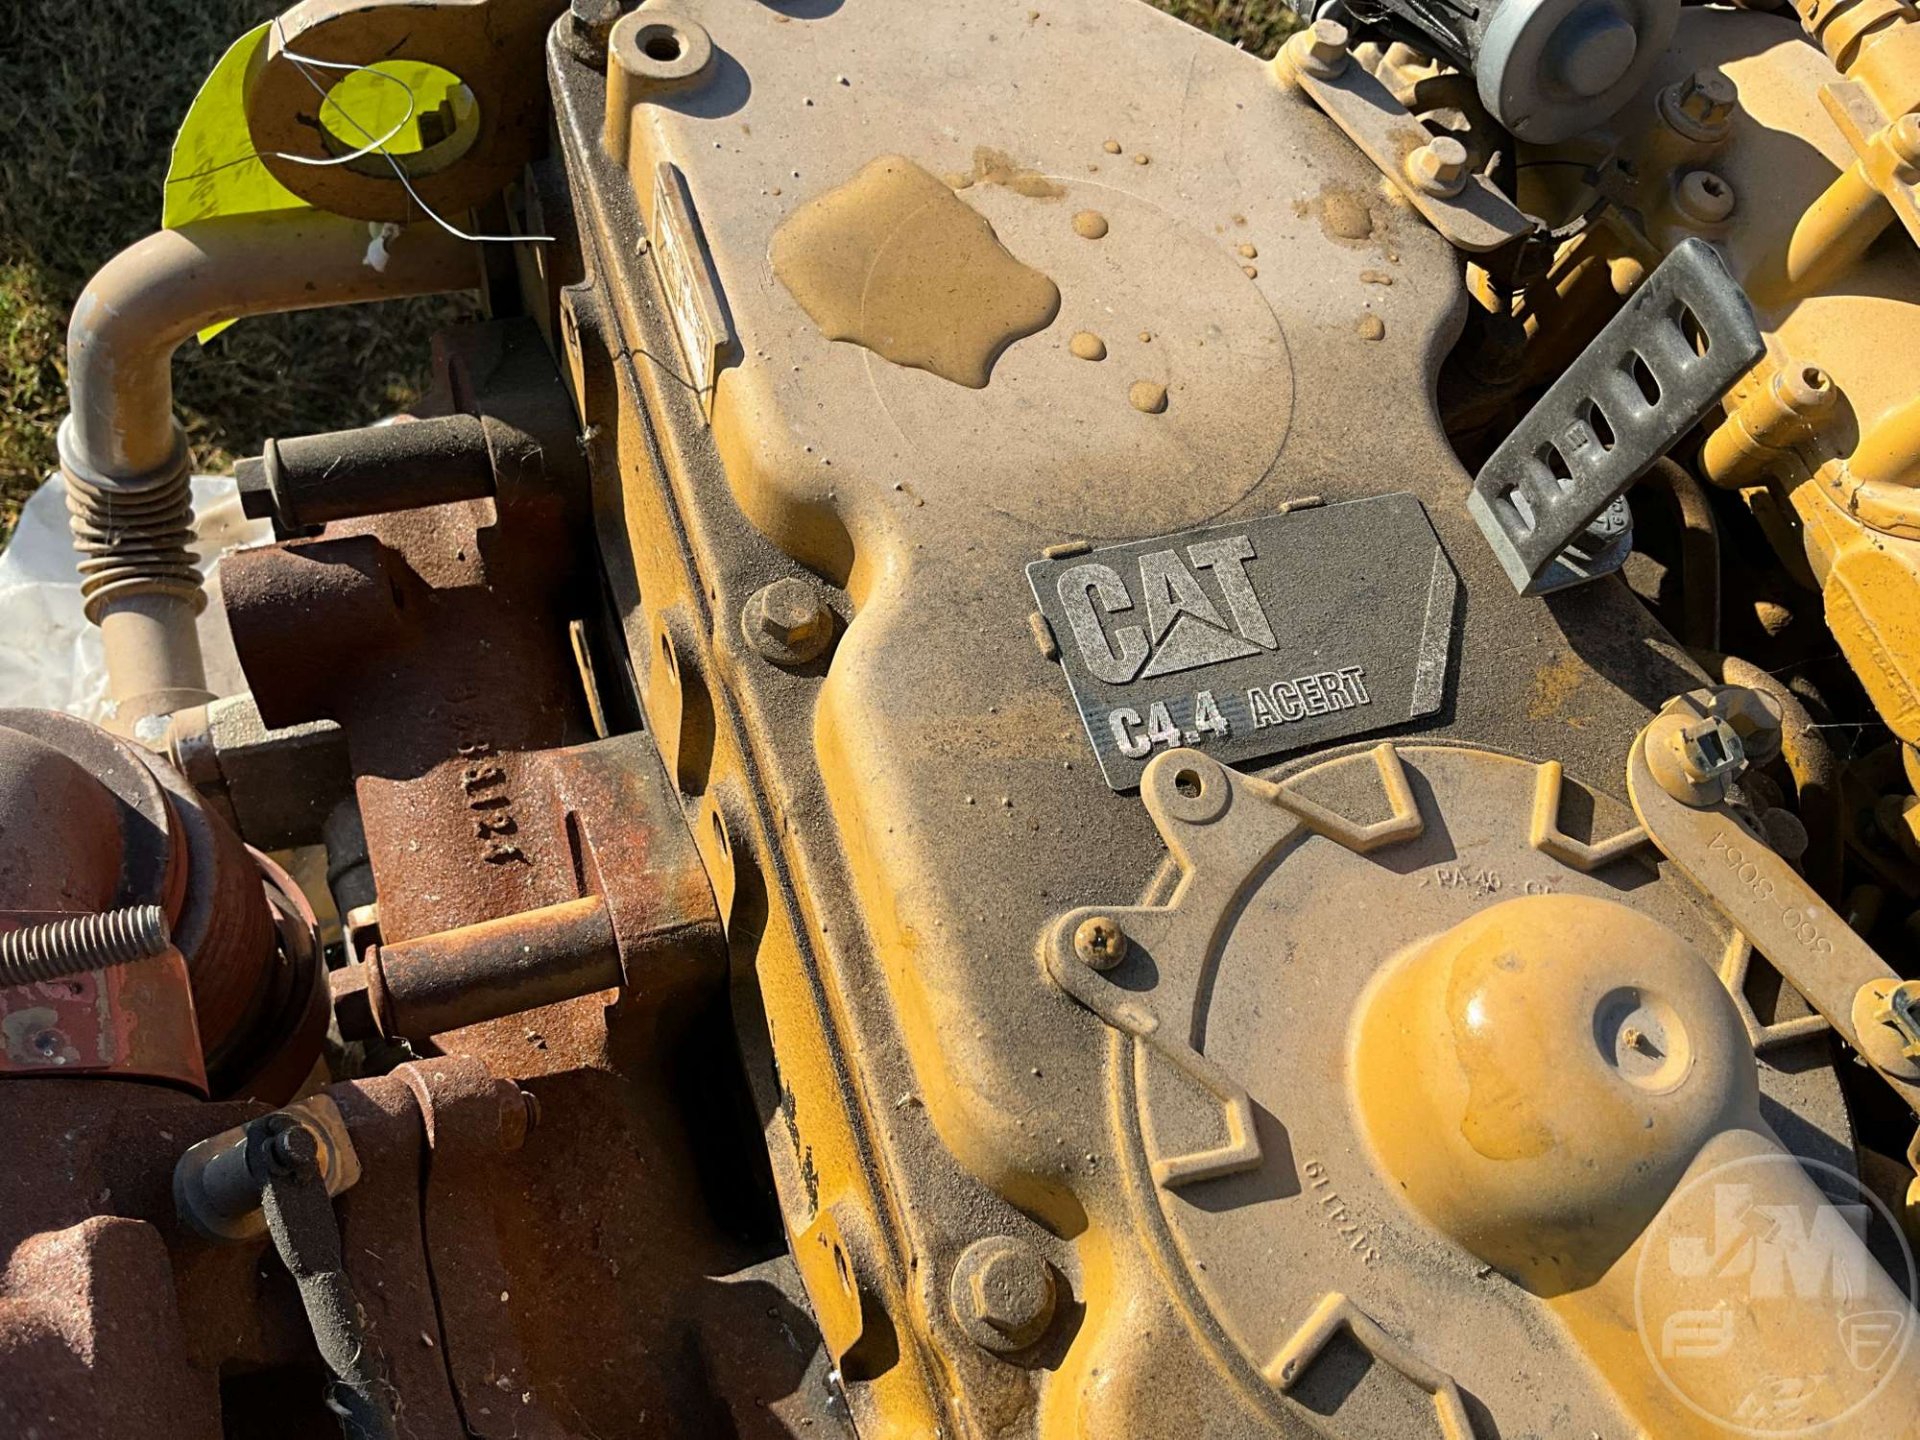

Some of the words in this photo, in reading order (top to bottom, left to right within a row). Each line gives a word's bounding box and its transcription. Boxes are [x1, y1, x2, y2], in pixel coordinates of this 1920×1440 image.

[1057, 534, 1279, 684] CAT
[1108, 689, 1230, 759] C4.4
[1247, 665, 1371, 730] ACERT
